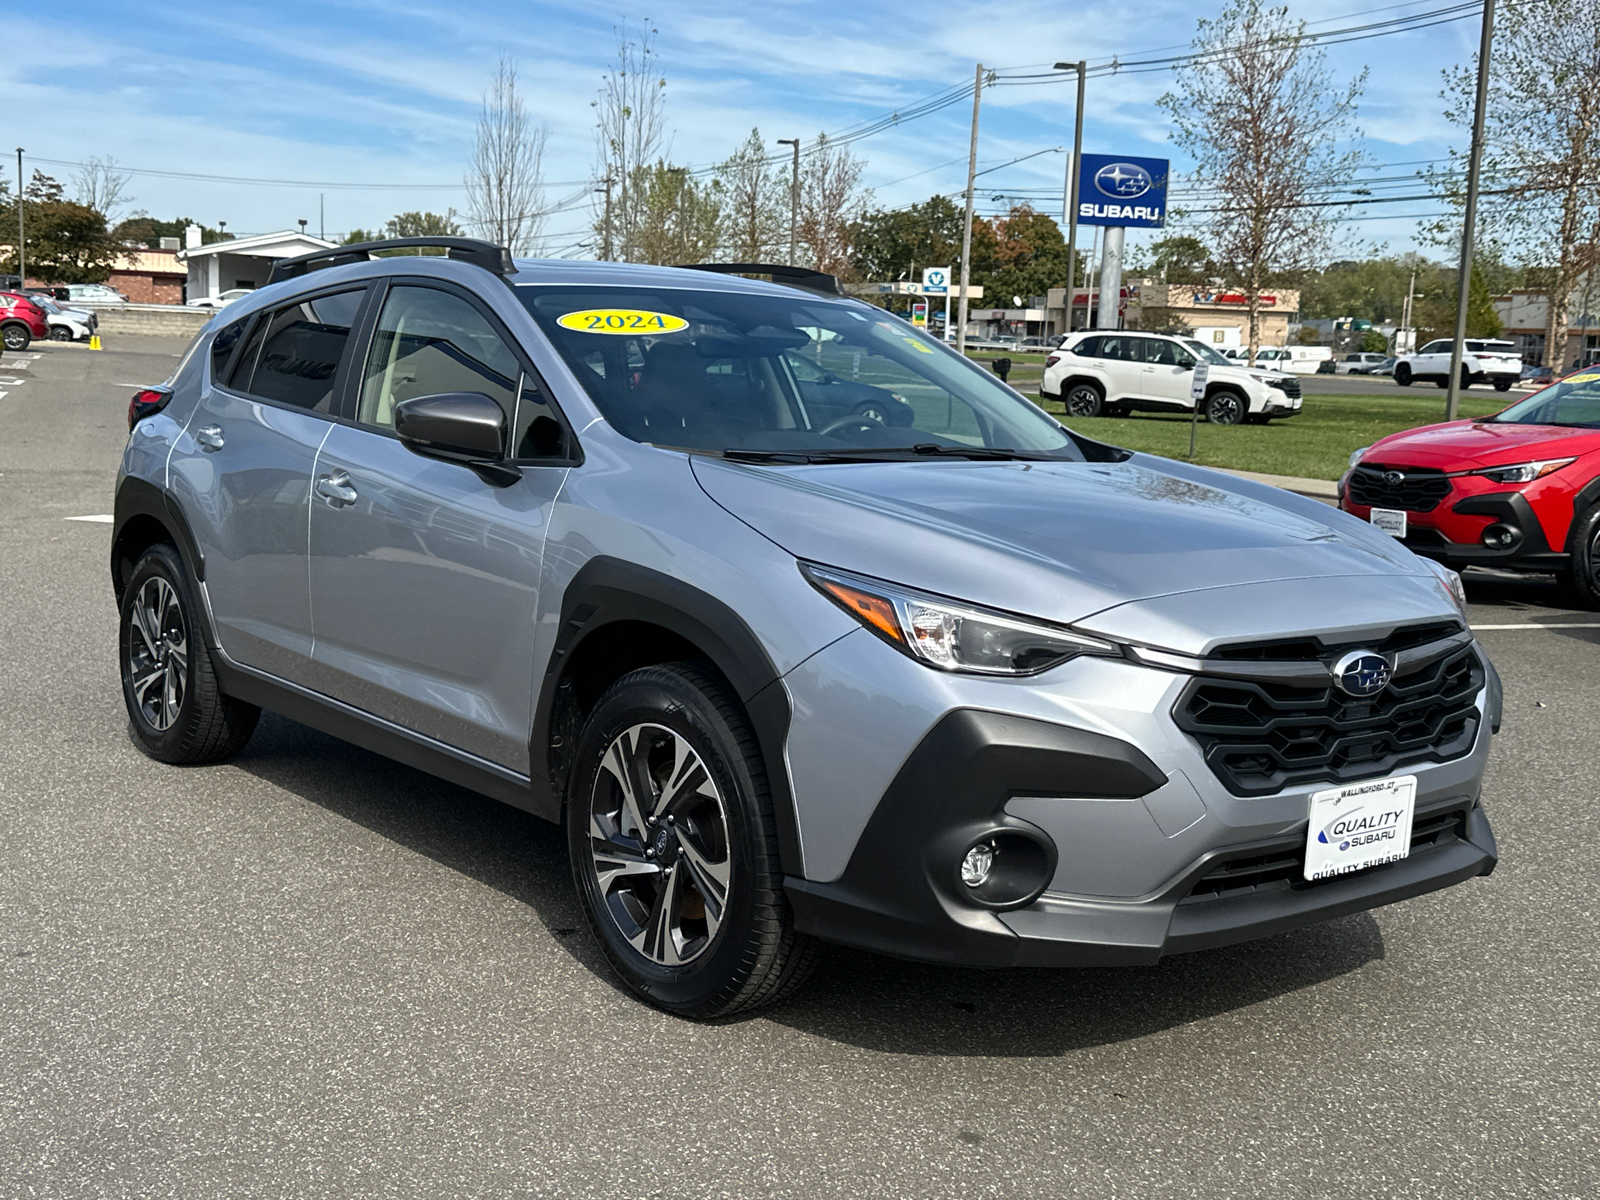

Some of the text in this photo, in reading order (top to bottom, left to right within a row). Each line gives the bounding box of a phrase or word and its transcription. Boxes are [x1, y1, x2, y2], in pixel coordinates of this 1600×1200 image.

[1079, 203, 1159, 220] SUBARU
[584, 315, 668, 329] 2024
[1333, 809, 1404, 835] QUALITY
[1351, 830, 1396, 847] SUBARU
[1312, 852, 1406, 880] QUALITY SUBARU
